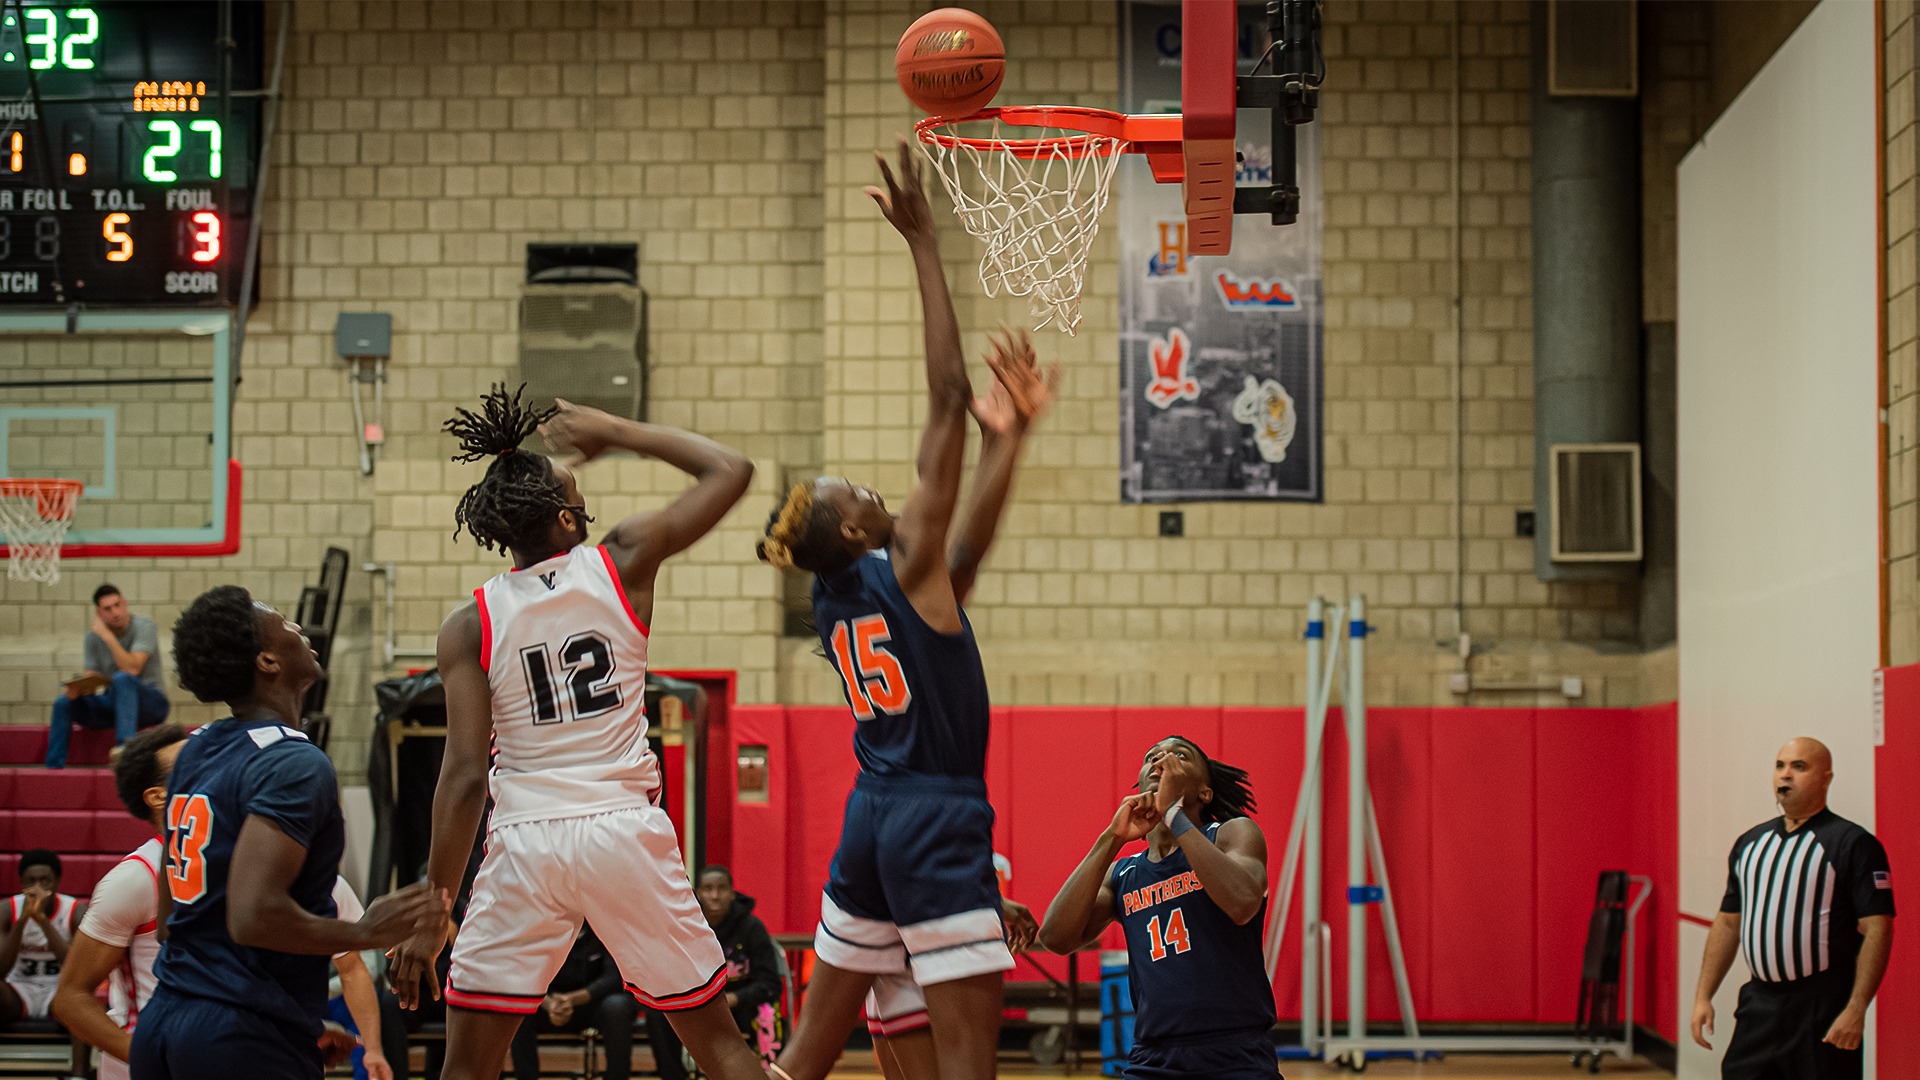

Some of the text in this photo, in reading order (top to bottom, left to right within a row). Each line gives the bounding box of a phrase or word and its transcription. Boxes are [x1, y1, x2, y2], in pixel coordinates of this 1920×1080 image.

[11, 131, 23, 172] 1
[143, 119, 222, 182] 27
[166, 189, 217, 210] FOUL
[103, 212, 133, 262] 5
[191, 212, 221, 262] 3
[0, 271, 218, 293] TCH SCOR
[519, 629, 625, 726] 12
[830, 613, 912, 721] 15
[1122, 869, 1204, 916] PANTHERS
[1146, 907, 1192, 962] 14
